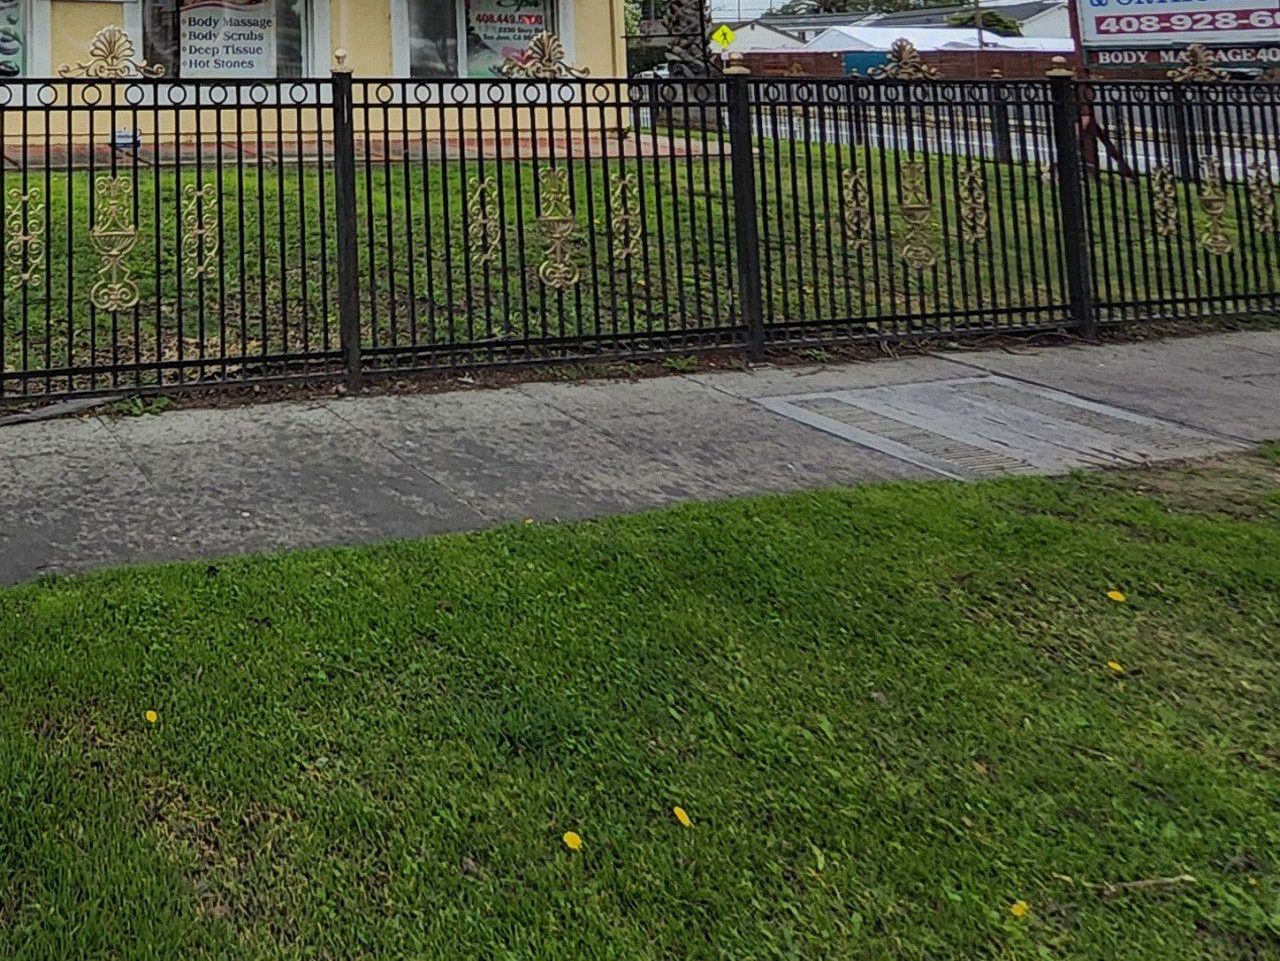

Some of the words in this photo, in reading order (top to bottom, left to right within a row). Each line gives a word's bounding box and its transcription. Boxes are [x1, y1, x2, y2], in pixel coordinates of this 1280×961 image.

[188, 16, 220, 29] Body
[223, 17, 272, 29] Massage
[188, 31, 220, 43] Body
[223, 31, 264, 41] Scrubs
[188, 45, 220, 57] Deep
[223, 45, 263, 55] Tissue
[1099, 51, 1149, 64] BODY
[189, 59, 209, 69] Hot
[213, 59, 254, 69] Stones
